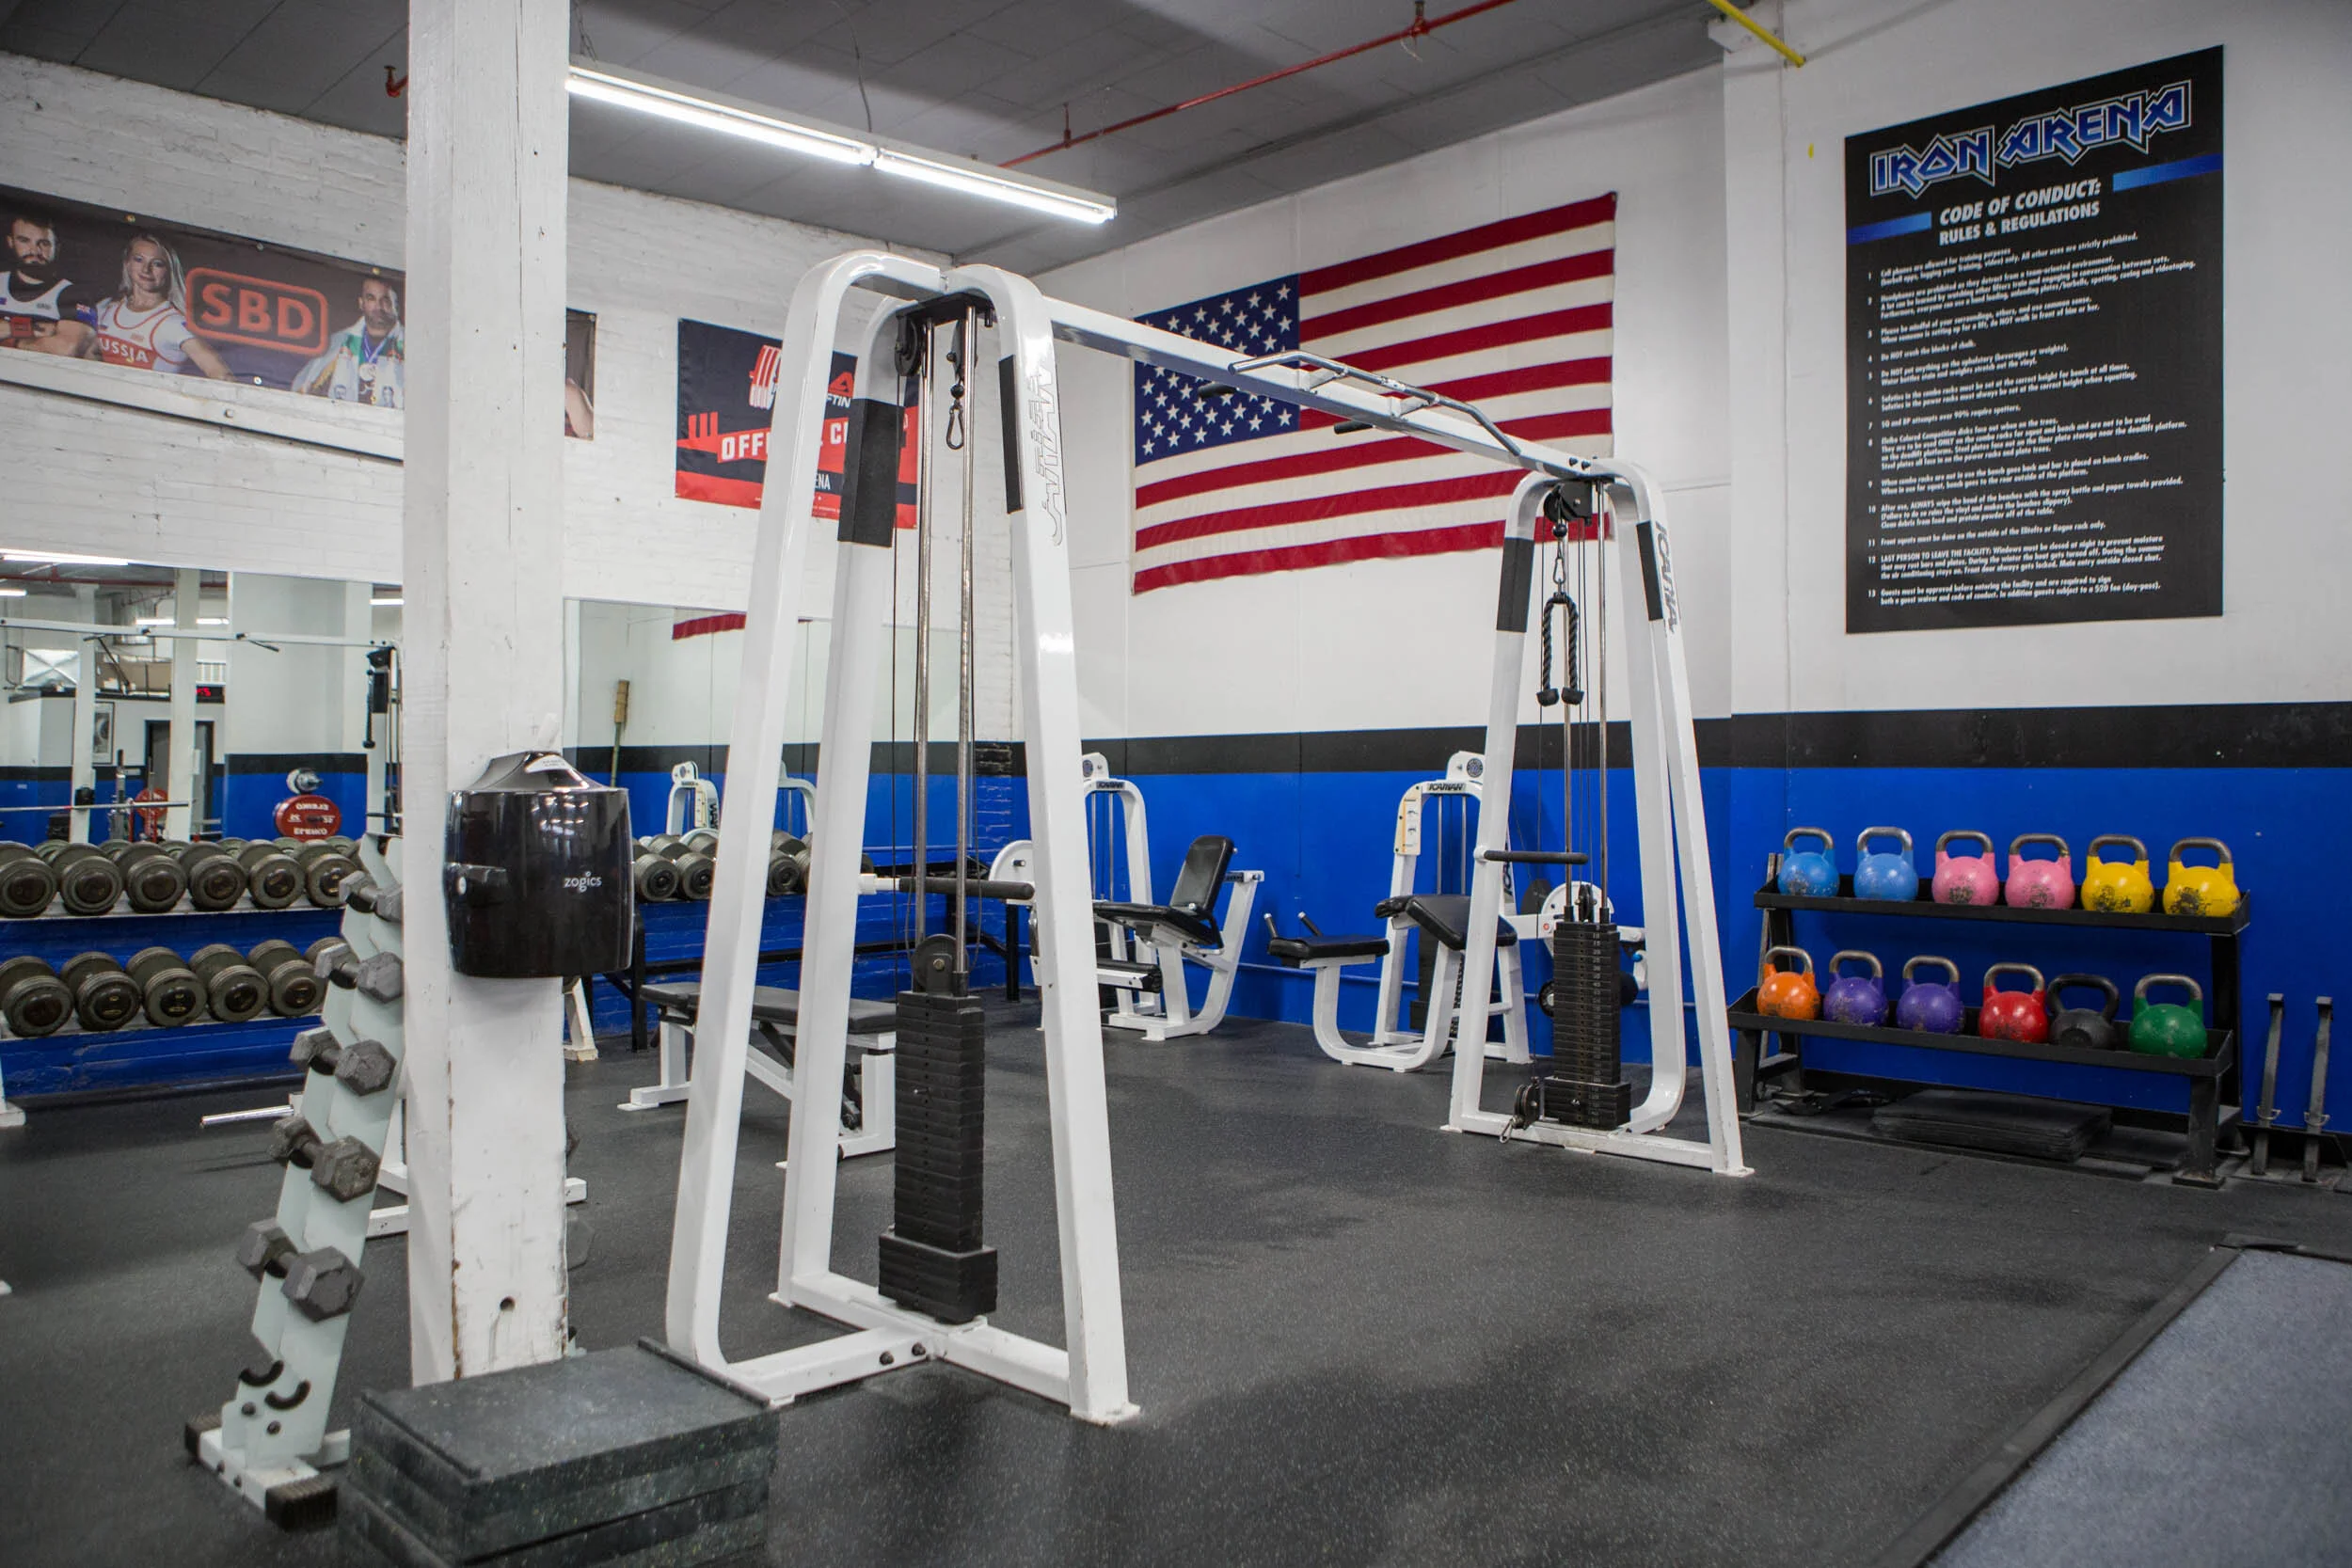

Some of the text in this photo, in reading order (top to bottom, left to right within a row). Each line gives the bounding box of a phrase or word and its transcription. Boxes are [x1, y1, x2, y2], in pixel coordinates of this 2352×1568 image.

[1870, 79, 2191, 199] IRON ARENA
[1939, 200, 2100, 246] RULES & REGULATIONS
[1940, 178, 2101, 226] CODE OF CONDUCT:
[202, 283, 312, 338] SBD
[99, 338, 149, 362] USSIA
[564, 871, 602, 893] zogics
